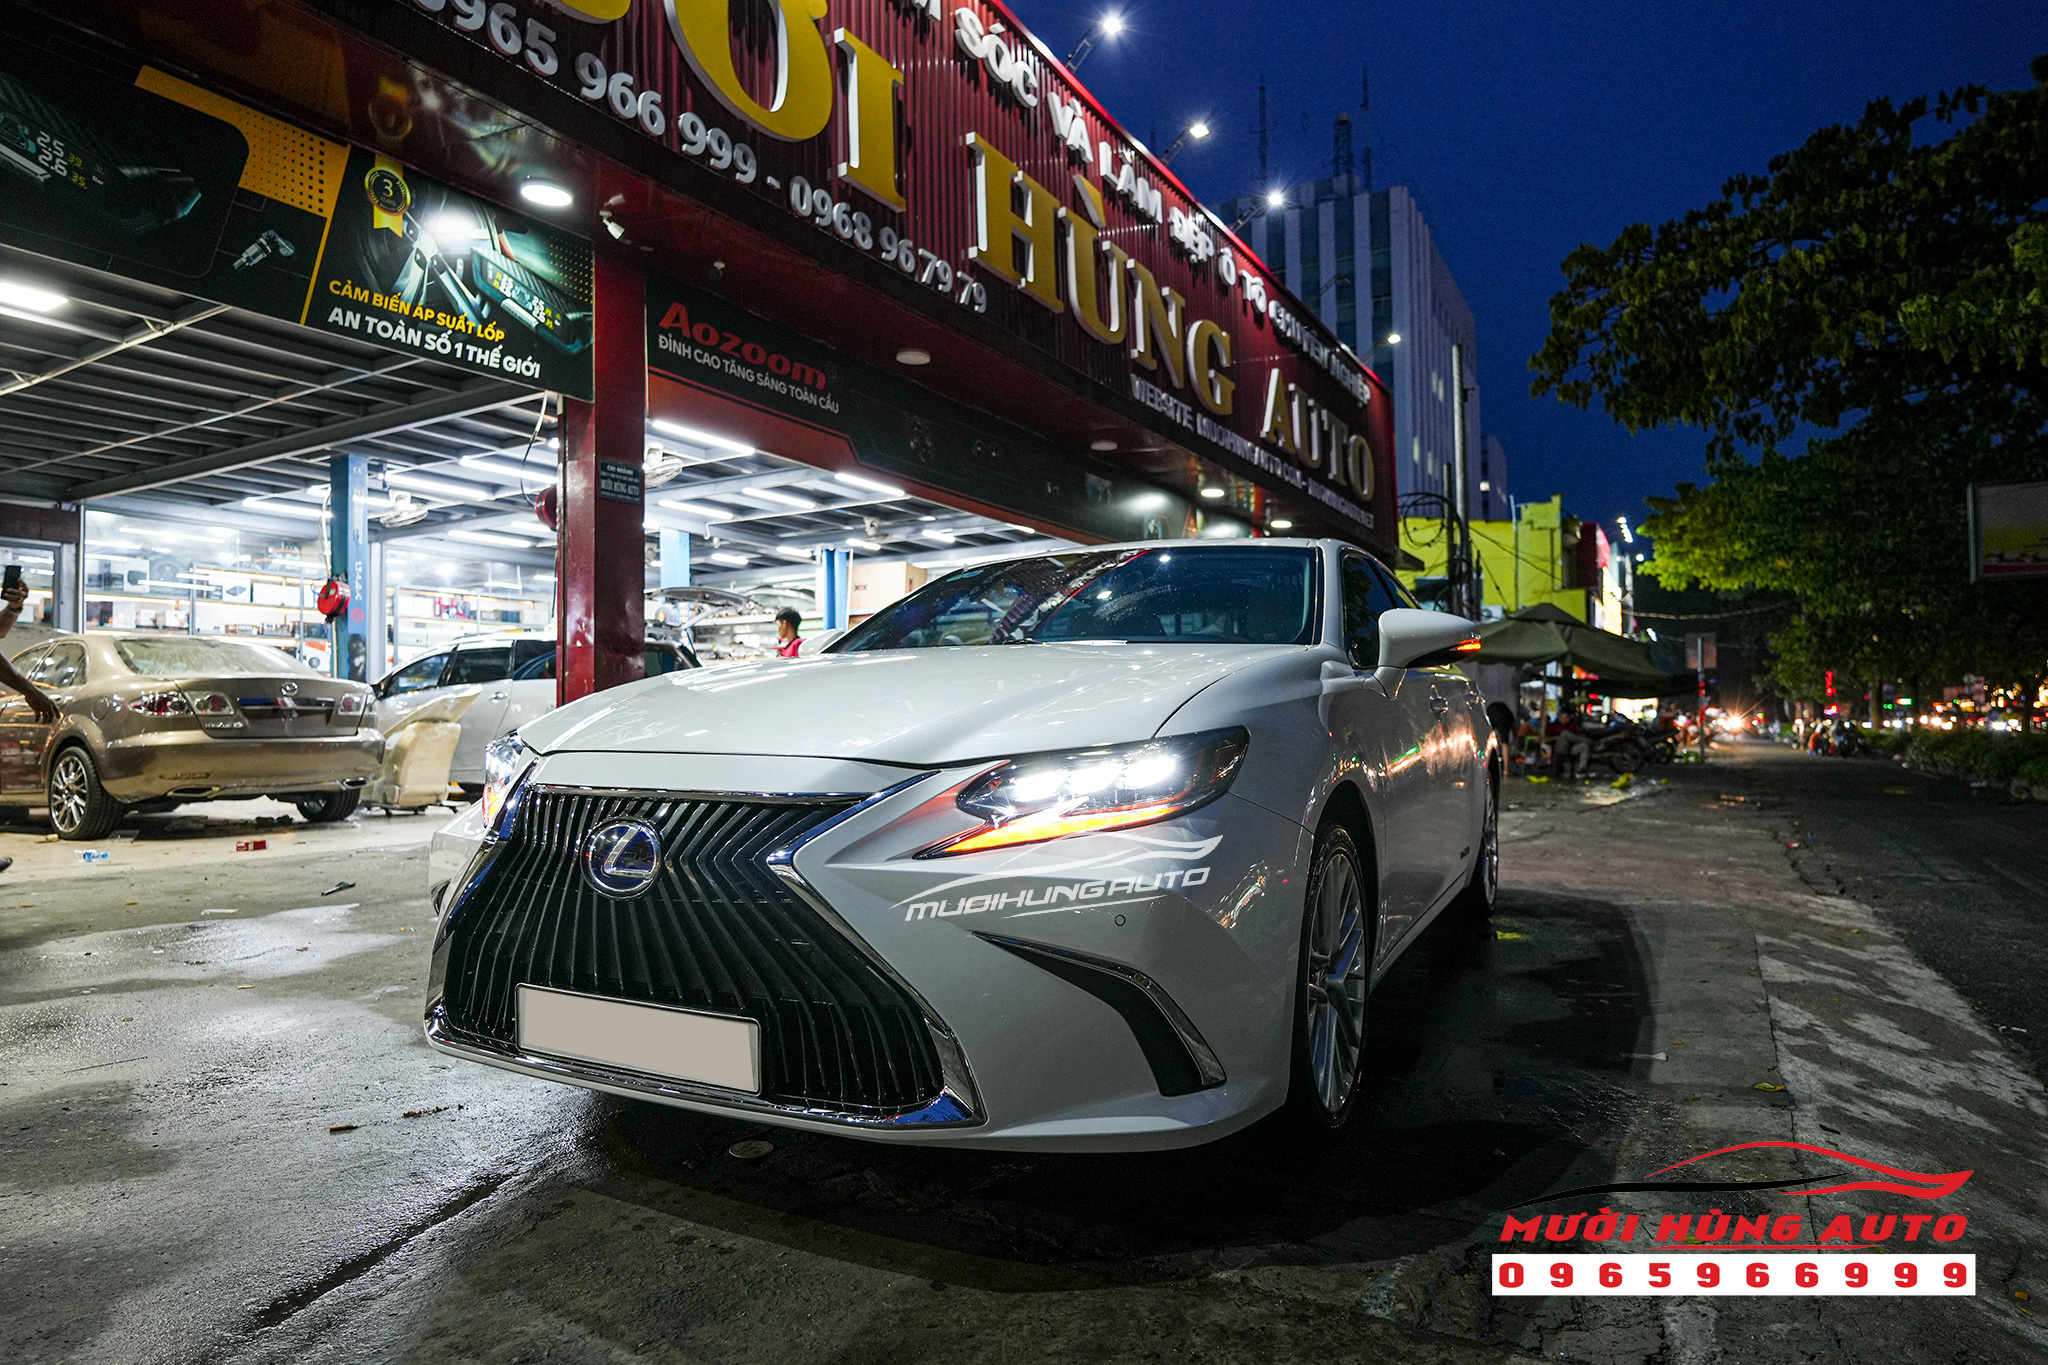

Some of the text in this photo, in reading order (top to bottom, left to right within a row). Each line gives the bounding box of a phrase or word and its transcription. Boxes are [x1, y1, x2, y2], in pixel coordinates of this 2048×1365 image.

[415, 0, 559, 77] 965
[574, 51, 667, 137] 966
[678, 111, 758, 185] 999
[790, 176, 873, 251] 0968
[954, 7, 1038, 108] SÓC
[1047, 92, 1094, 164] VÀ
[1218, 247, 1237, 286] Ô
[1238, 269, 1267, 314] TÔ
[382, 178, 394, 198] 3
[327, 306, 541, 379] AN TOÀN SỐ 1 THẾ GIỚI
[328, 279, 506, 343] CẢM BIẾN ÁP SUẤT LỐP
[658, 301, 827, 391] Aozoom
[965, 132, 1237, 418] HÙNG
[1260, 367, 1375, 501] AUTO
[658, 333, 840, 415] ĐỈNH CAO TĂNG SÁNG TOÀN CẦU
[1130, 373, 1195, 433] WEBSITE
